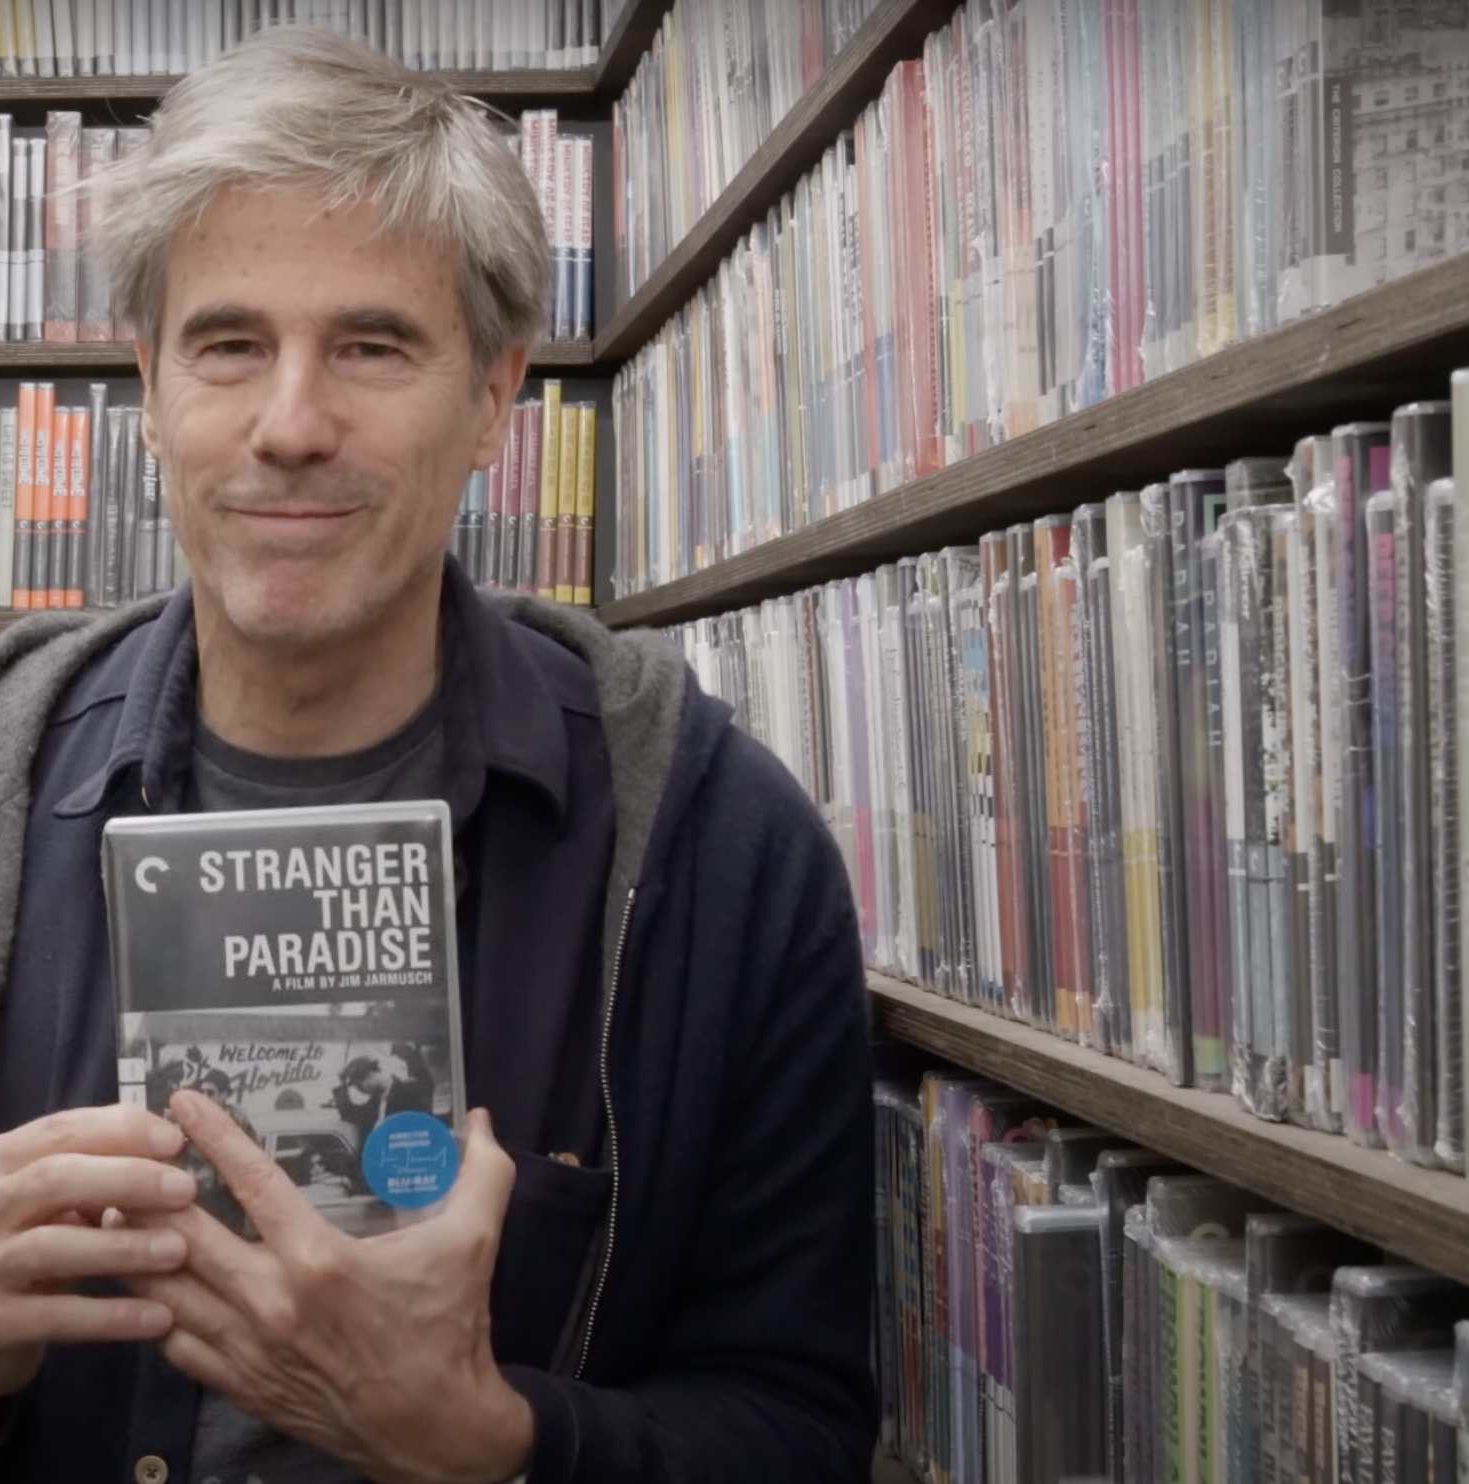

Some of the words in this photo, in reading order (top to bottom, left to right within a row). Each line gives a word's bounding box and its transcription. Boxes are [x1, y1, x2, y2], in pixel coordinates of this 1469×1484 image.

[1332, 84, 1342, 104] THE
[1332, 109, 1342, 163] CRITERION
[1332, 168, 1343, 233] COLLECTION
[0, 469, 14, 508] SWEET
[1170, 510, 1193, 666] PARIAH
[1374, 531, 1394, 622] DEEP
[1203, 590, 1222, 748] PARIAH
[1376, 628, 1395, 748] COVER
[200, 843, 428, 893] STRANGER
[314, 886, 429, 929] THAN
[225, 927, 432, 977] PARADISE
[272, 978, 281, 991] A
[285, 977, 315, 991] FILM
[320, 976, 336, 989] BY
[339, 975, 361, 989] JIM
[364, 971, 432, 988] JARMUSCH
[231, 1066, 322, 1097] Florida
[388, 1174, 437, 1188] BLU-RAY
